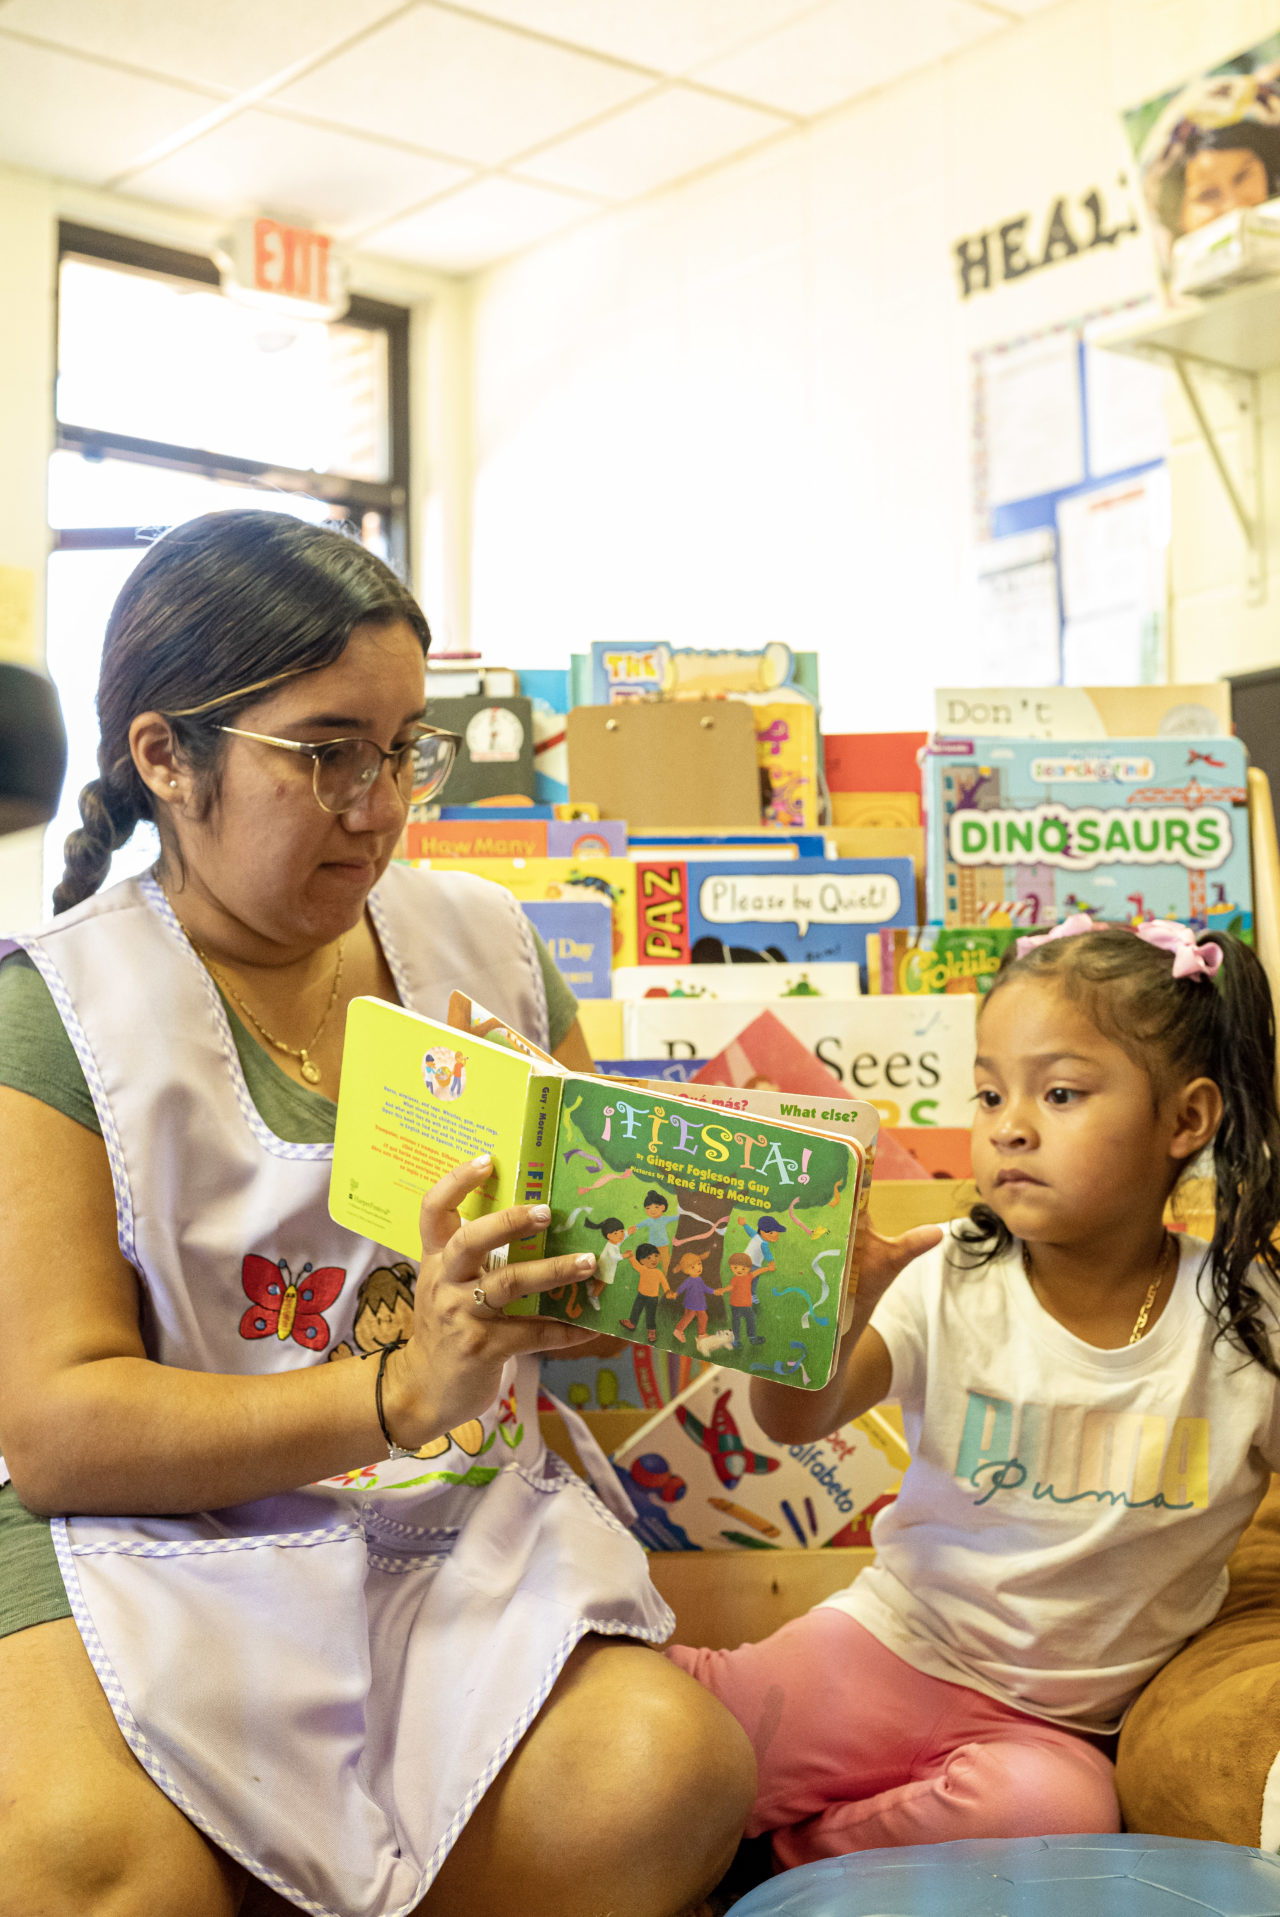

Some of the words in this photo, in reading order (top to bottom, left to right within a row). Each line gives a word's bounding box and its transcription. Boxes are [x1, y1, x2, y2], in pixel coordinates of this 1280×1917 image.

[955, 170, 1139, 297] HEAL
[254, 218, 330, 305] EXIT
[947, 697, 1053, 725] Don't
[420, 836, 470, 856] How
[473, 837, 537, 858] Many
[961, 817, 1222, 857] DINOSAURS
[643, 868, 682, 958] PAZ
[711, 880, 785, 913] Please
[792, 884, 811, 911] be
[819, 882, 888, 914] Quiet!
[815, 1036, 941, 1088] Sees
[539, 1086, 550, 1104] Guy
[712, 1097, 750, 1112] más?
[780, 1103, 817, 1120] What
[821, 1107, 858, 1123] else?
[535, 1112, 547, 1148] Moreno
[601, 1101, 812, 1185] ¡FIESTA!
[630, 1165, 655, 1178] Pictures
[667, 1172, 696, 1191] René
[699, 1181, 725, 1200] King
[727, 1188, 772, 1210] Moreno
[646, 1154, 684, 1173] Ginger
[686, 1164, 745, 1190] Foglesong
[747, 1178, 770, 1196] Guy
[789, 1443, 854, 1513] alfabeto
[970, 1458, 1194, 1510] Puma
